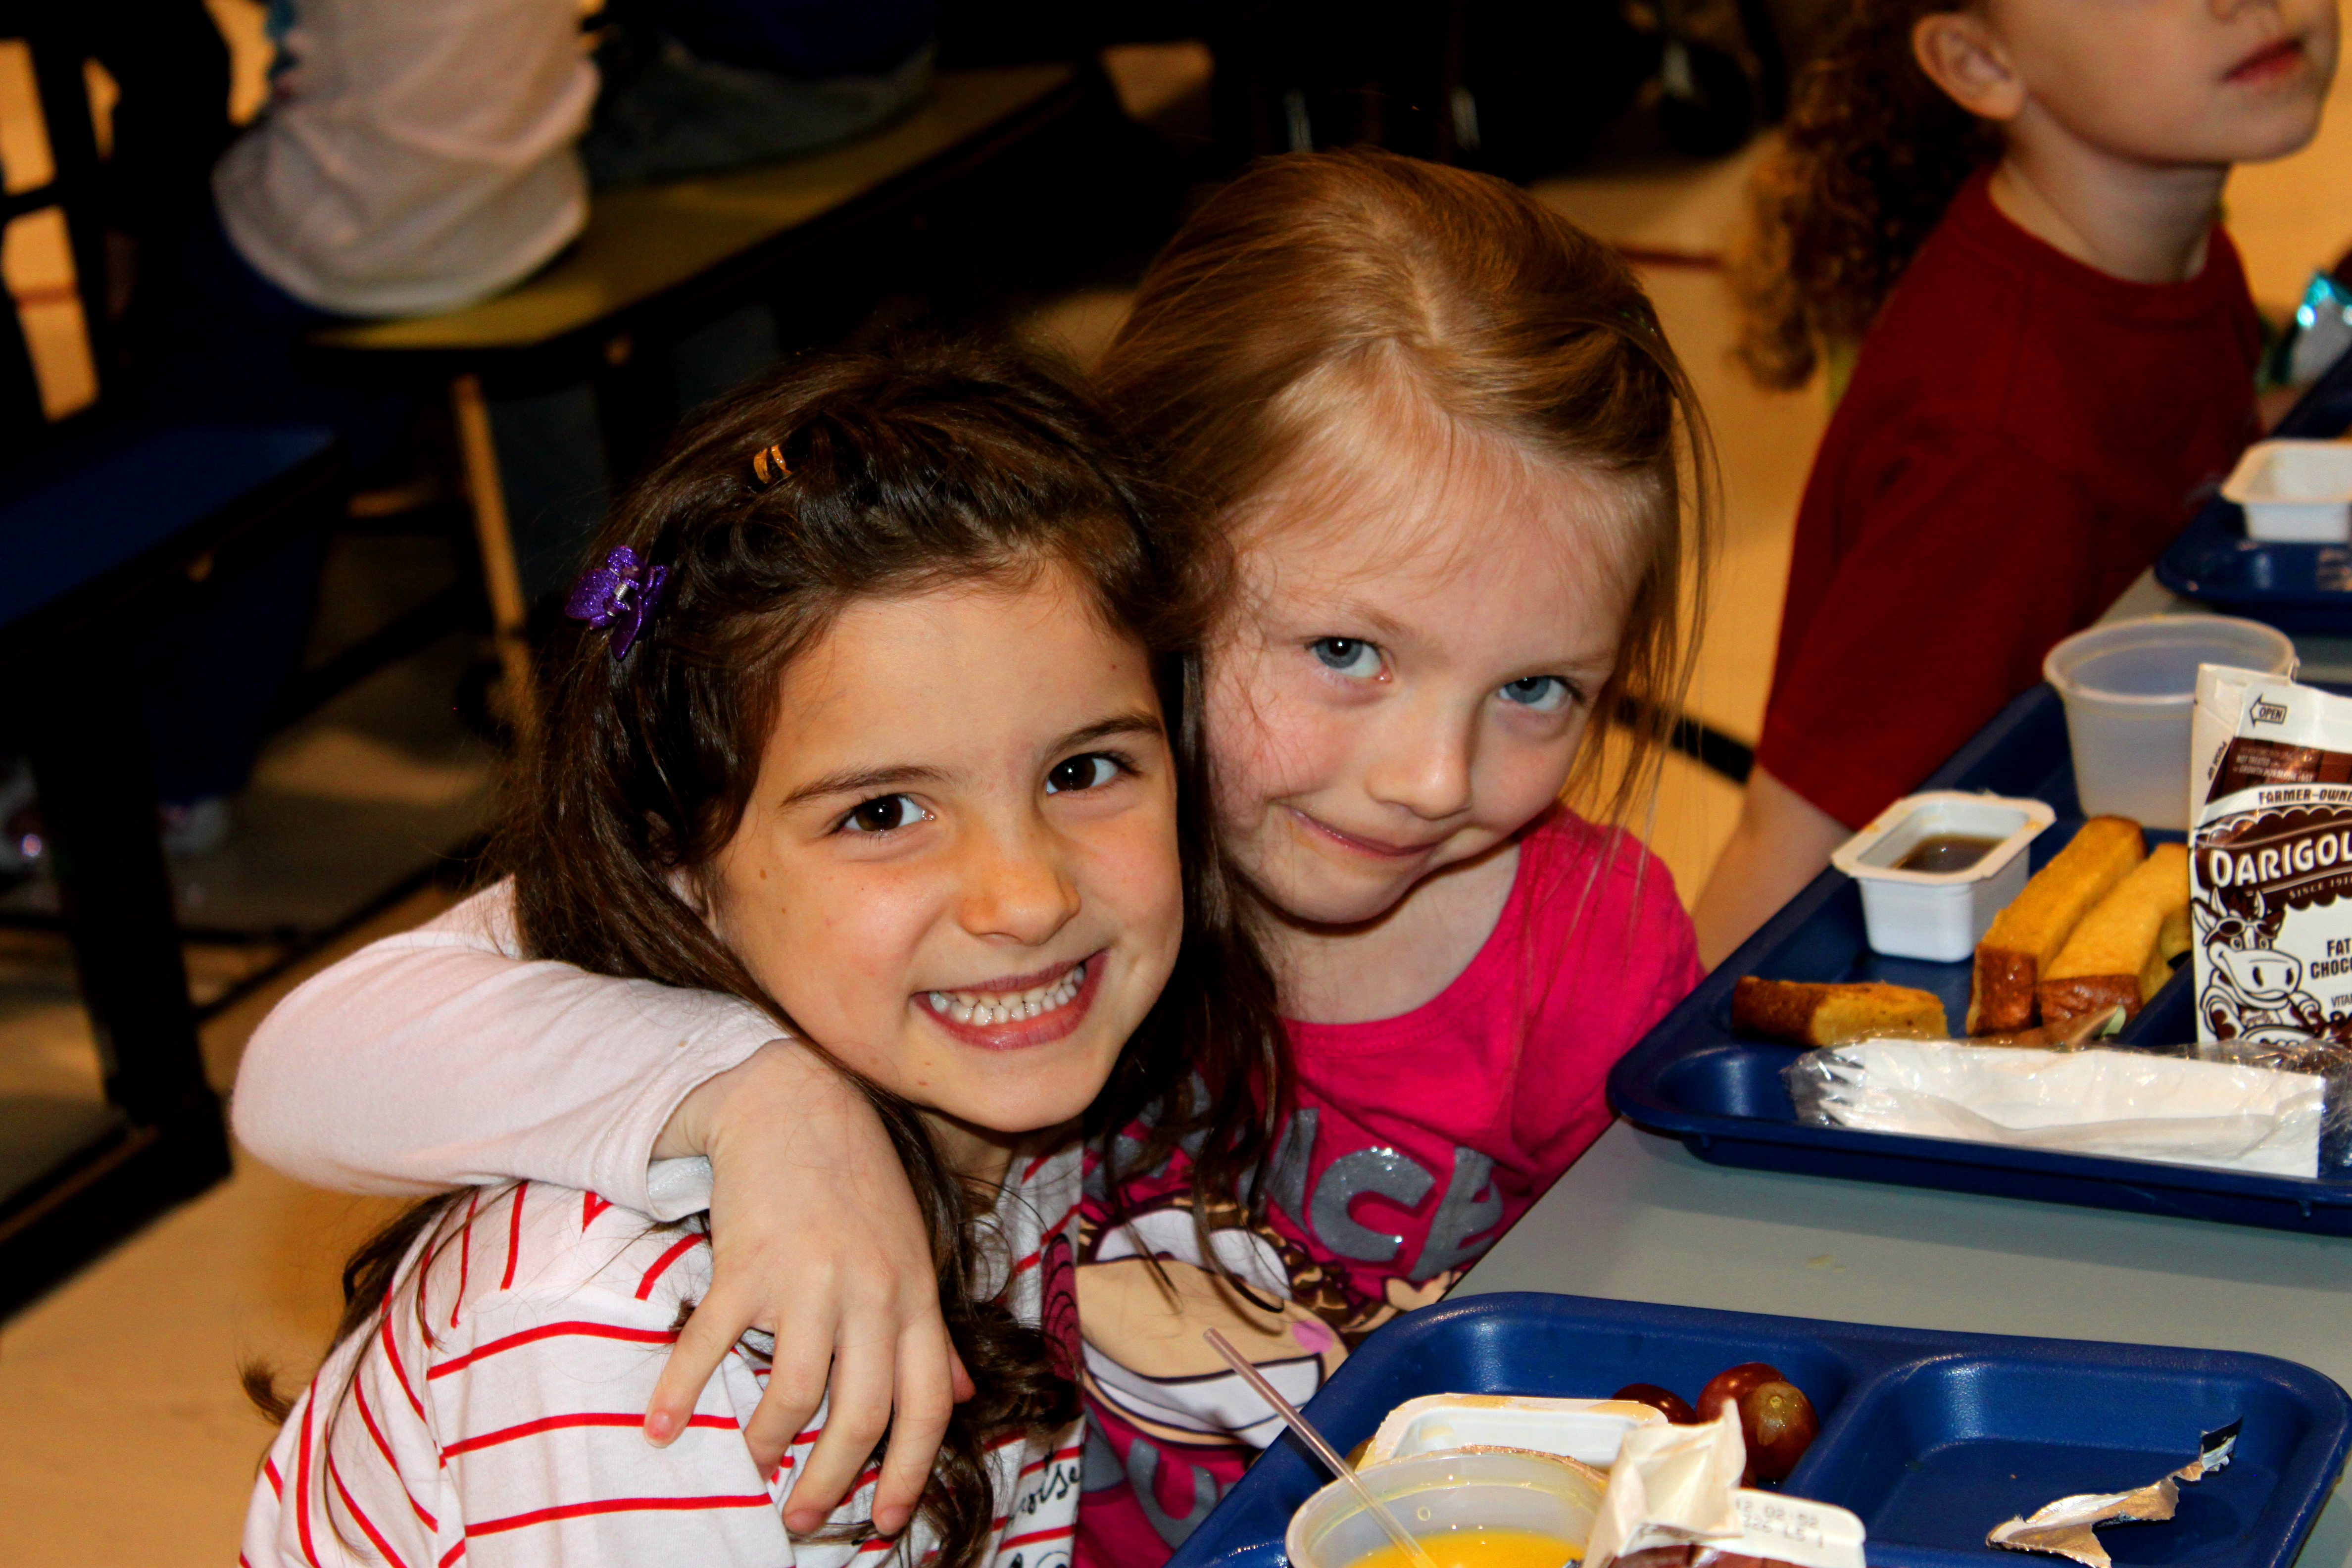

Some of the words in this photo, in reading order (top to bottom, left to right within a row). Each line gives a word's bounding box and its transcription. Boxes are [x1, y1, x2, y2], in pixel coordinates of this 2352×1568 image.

[2259, 706, 2283, 719] OPEN
[2209, 831, 2352, 888] DARIGOL
[2289, 882, 2324, 900] SINCE
[2327, 938, 2351, 958] FAT
[2310, 956, 2352, 980] CHOC
[2331, 993, 2352, 1008] VITA
